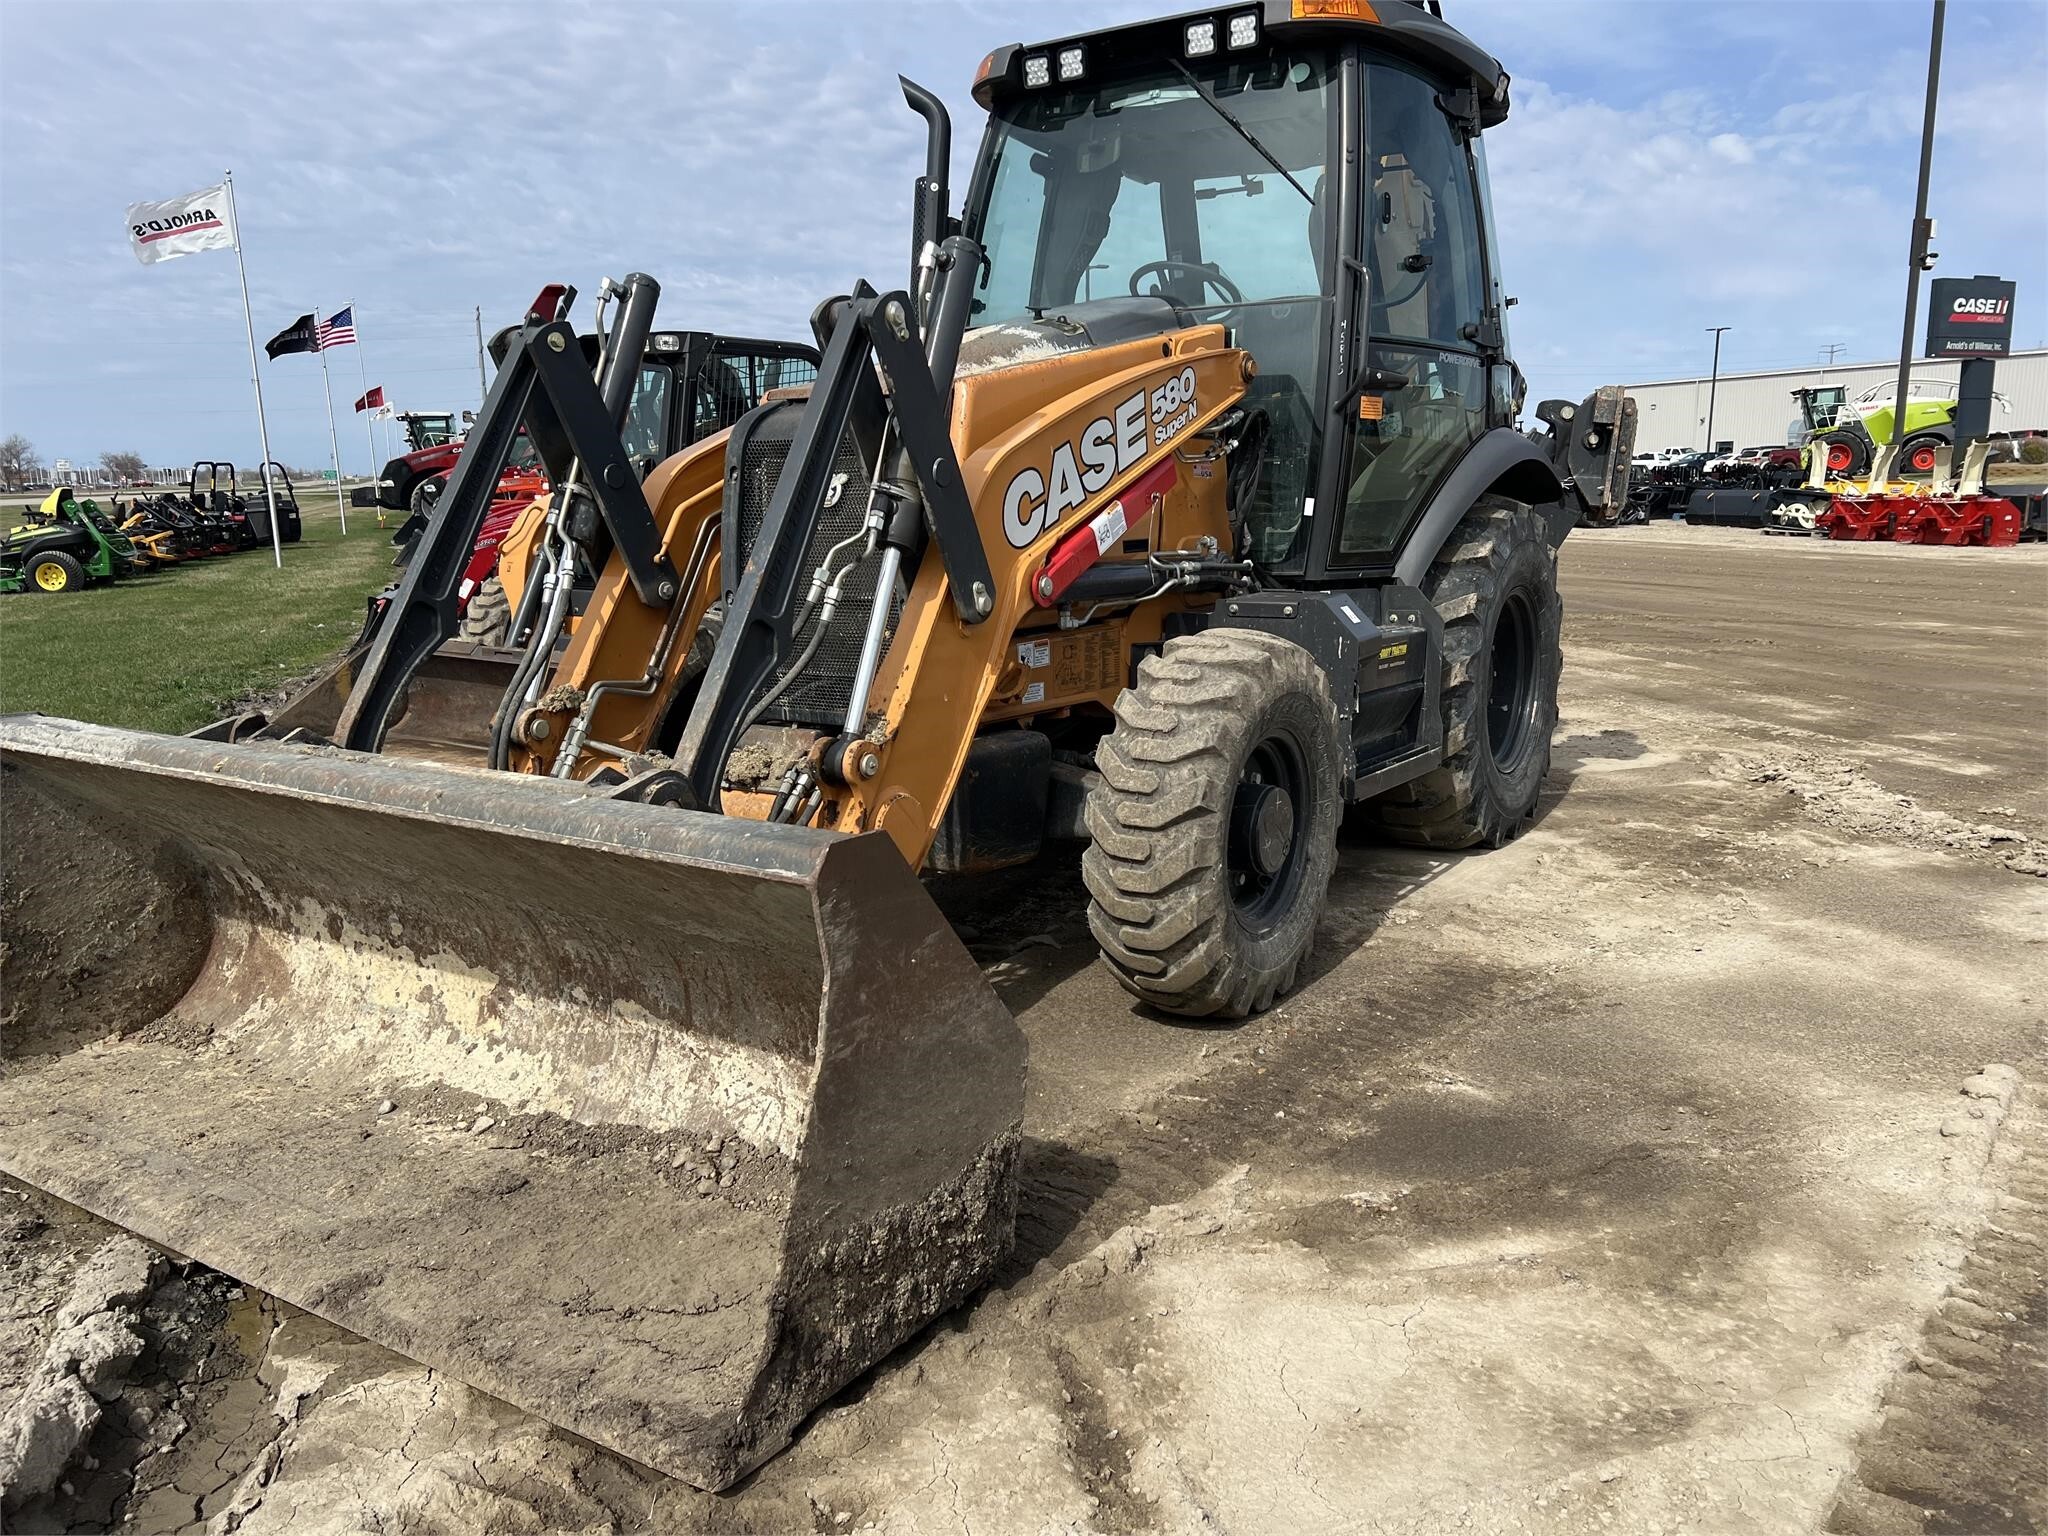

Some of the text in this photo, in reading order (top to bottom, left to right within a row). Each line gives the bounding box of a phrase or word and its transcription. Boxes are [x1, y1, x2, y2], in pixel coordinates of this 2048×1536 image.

[1953, 297, 1996, 313] CASE
[1946, 341, 1968, 350] Arnold's
[1151, 366, 1196, 423] 580
[1154, 399, 1198, 446] Super N
[1002, 388, 1148, 548] CASE
